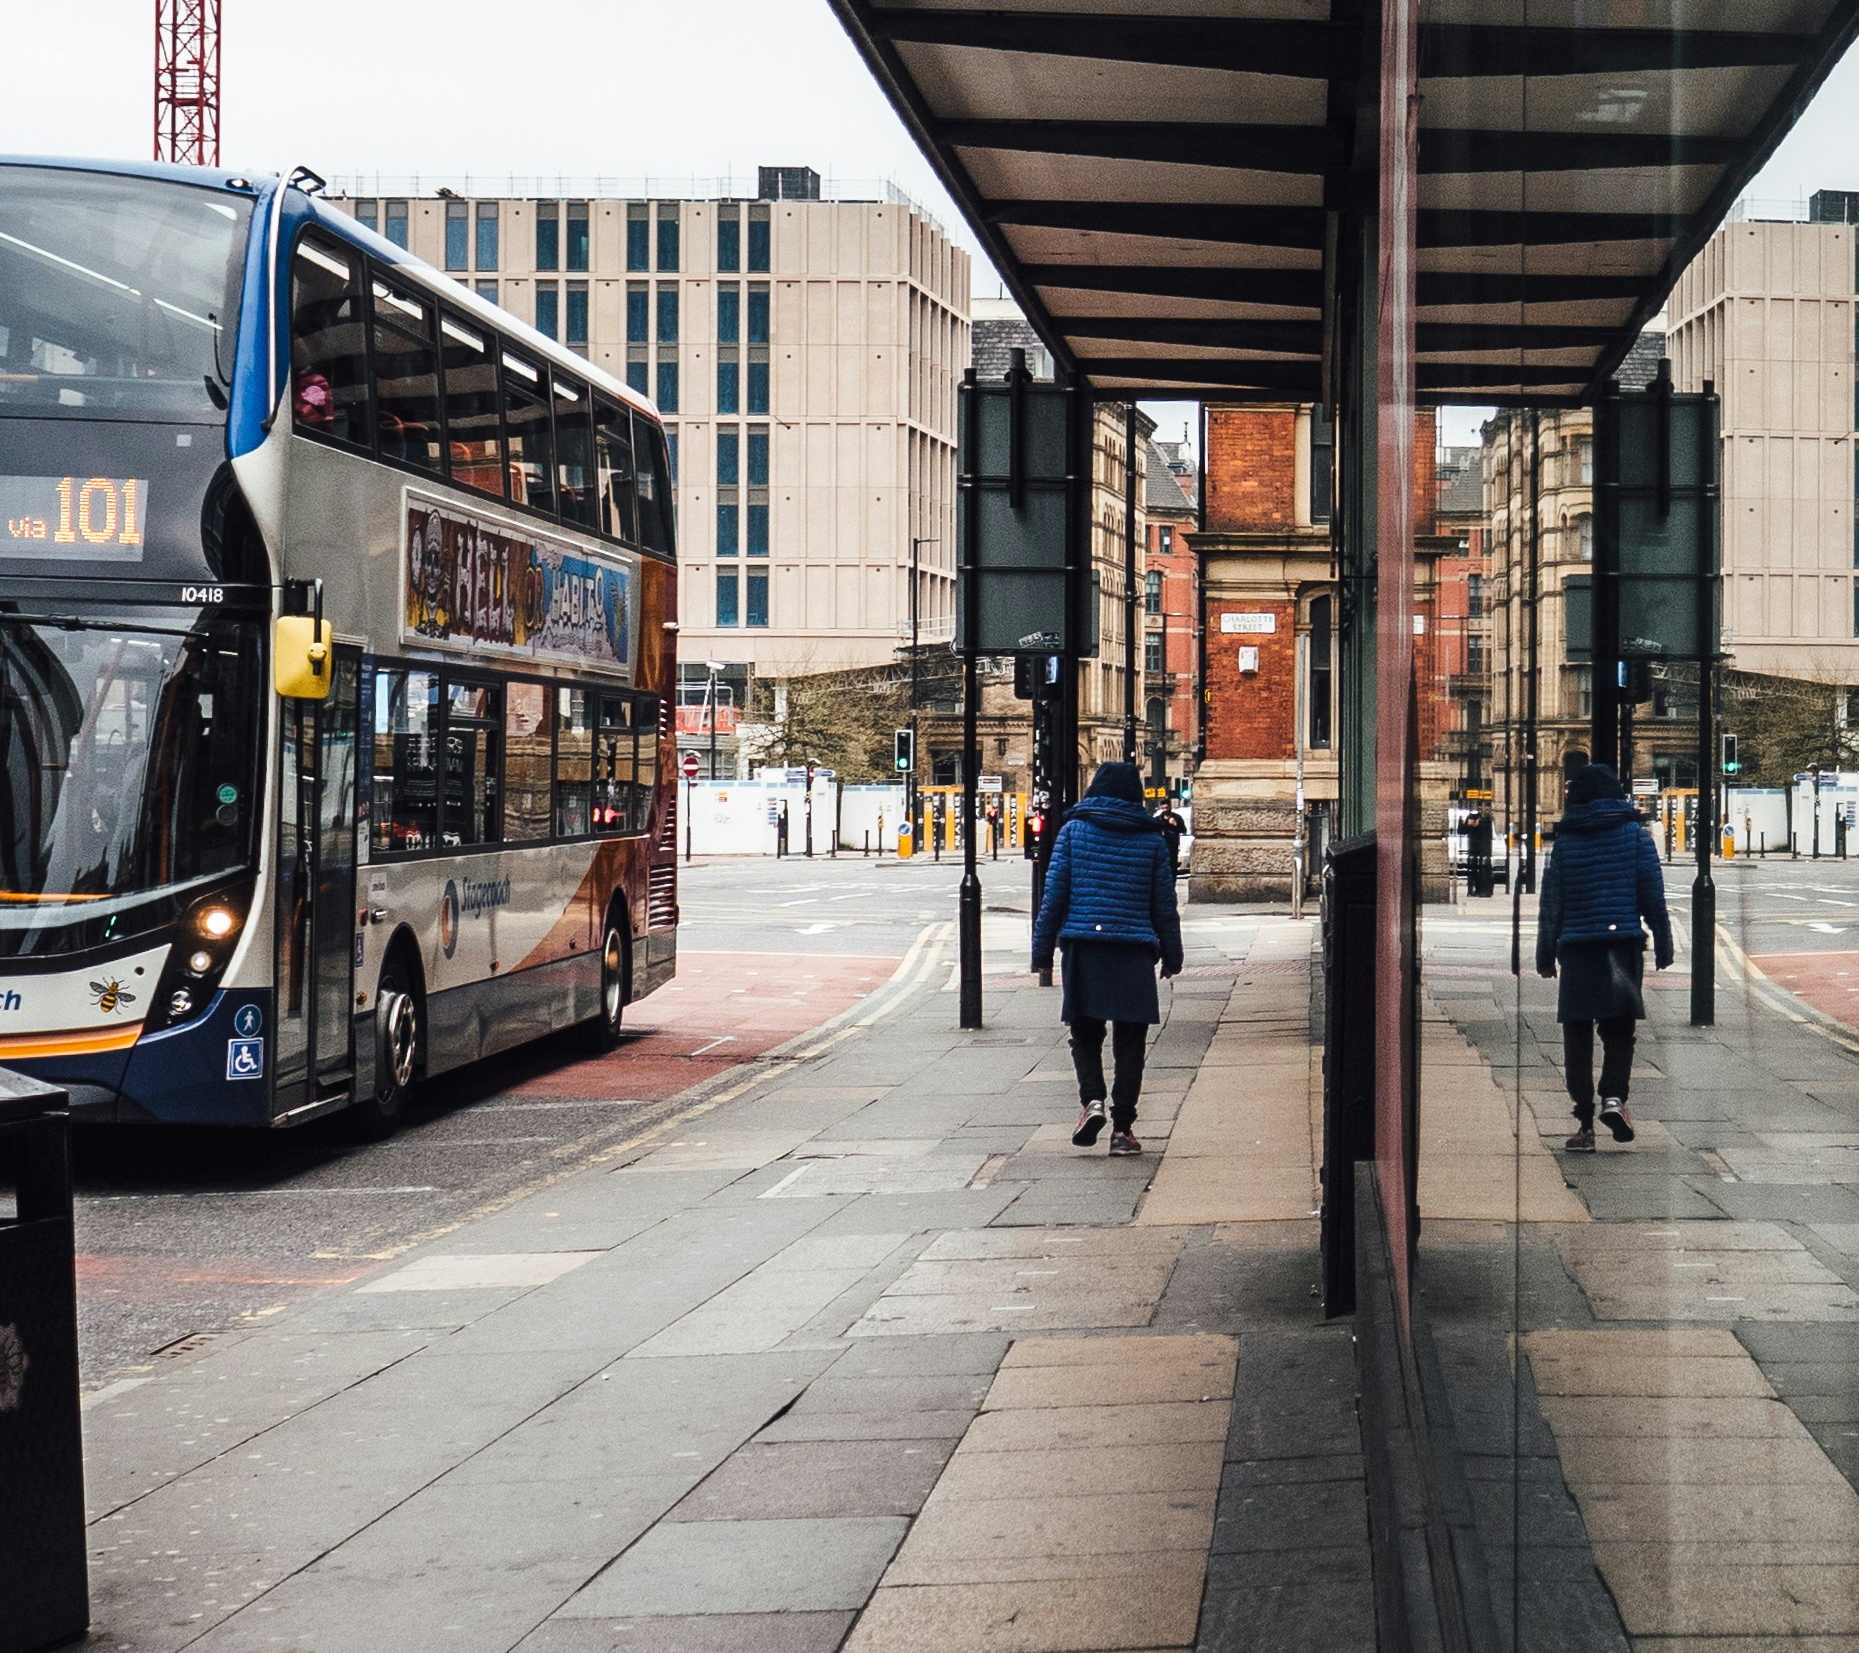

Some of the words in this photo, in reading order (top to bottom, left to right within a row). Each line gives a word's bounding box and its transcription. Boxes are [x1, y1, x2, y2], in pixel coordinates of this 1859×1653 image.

[8, 516, 47, 539] via
[54, 477, 142, 544] 101
[181, 587, 223, 603] 10418
[1223, 615, 1273, 623] CHARLOTTE
[1232, 623, 1263, 631] STREET
[461, 876, 512, 919] Stagecoach
